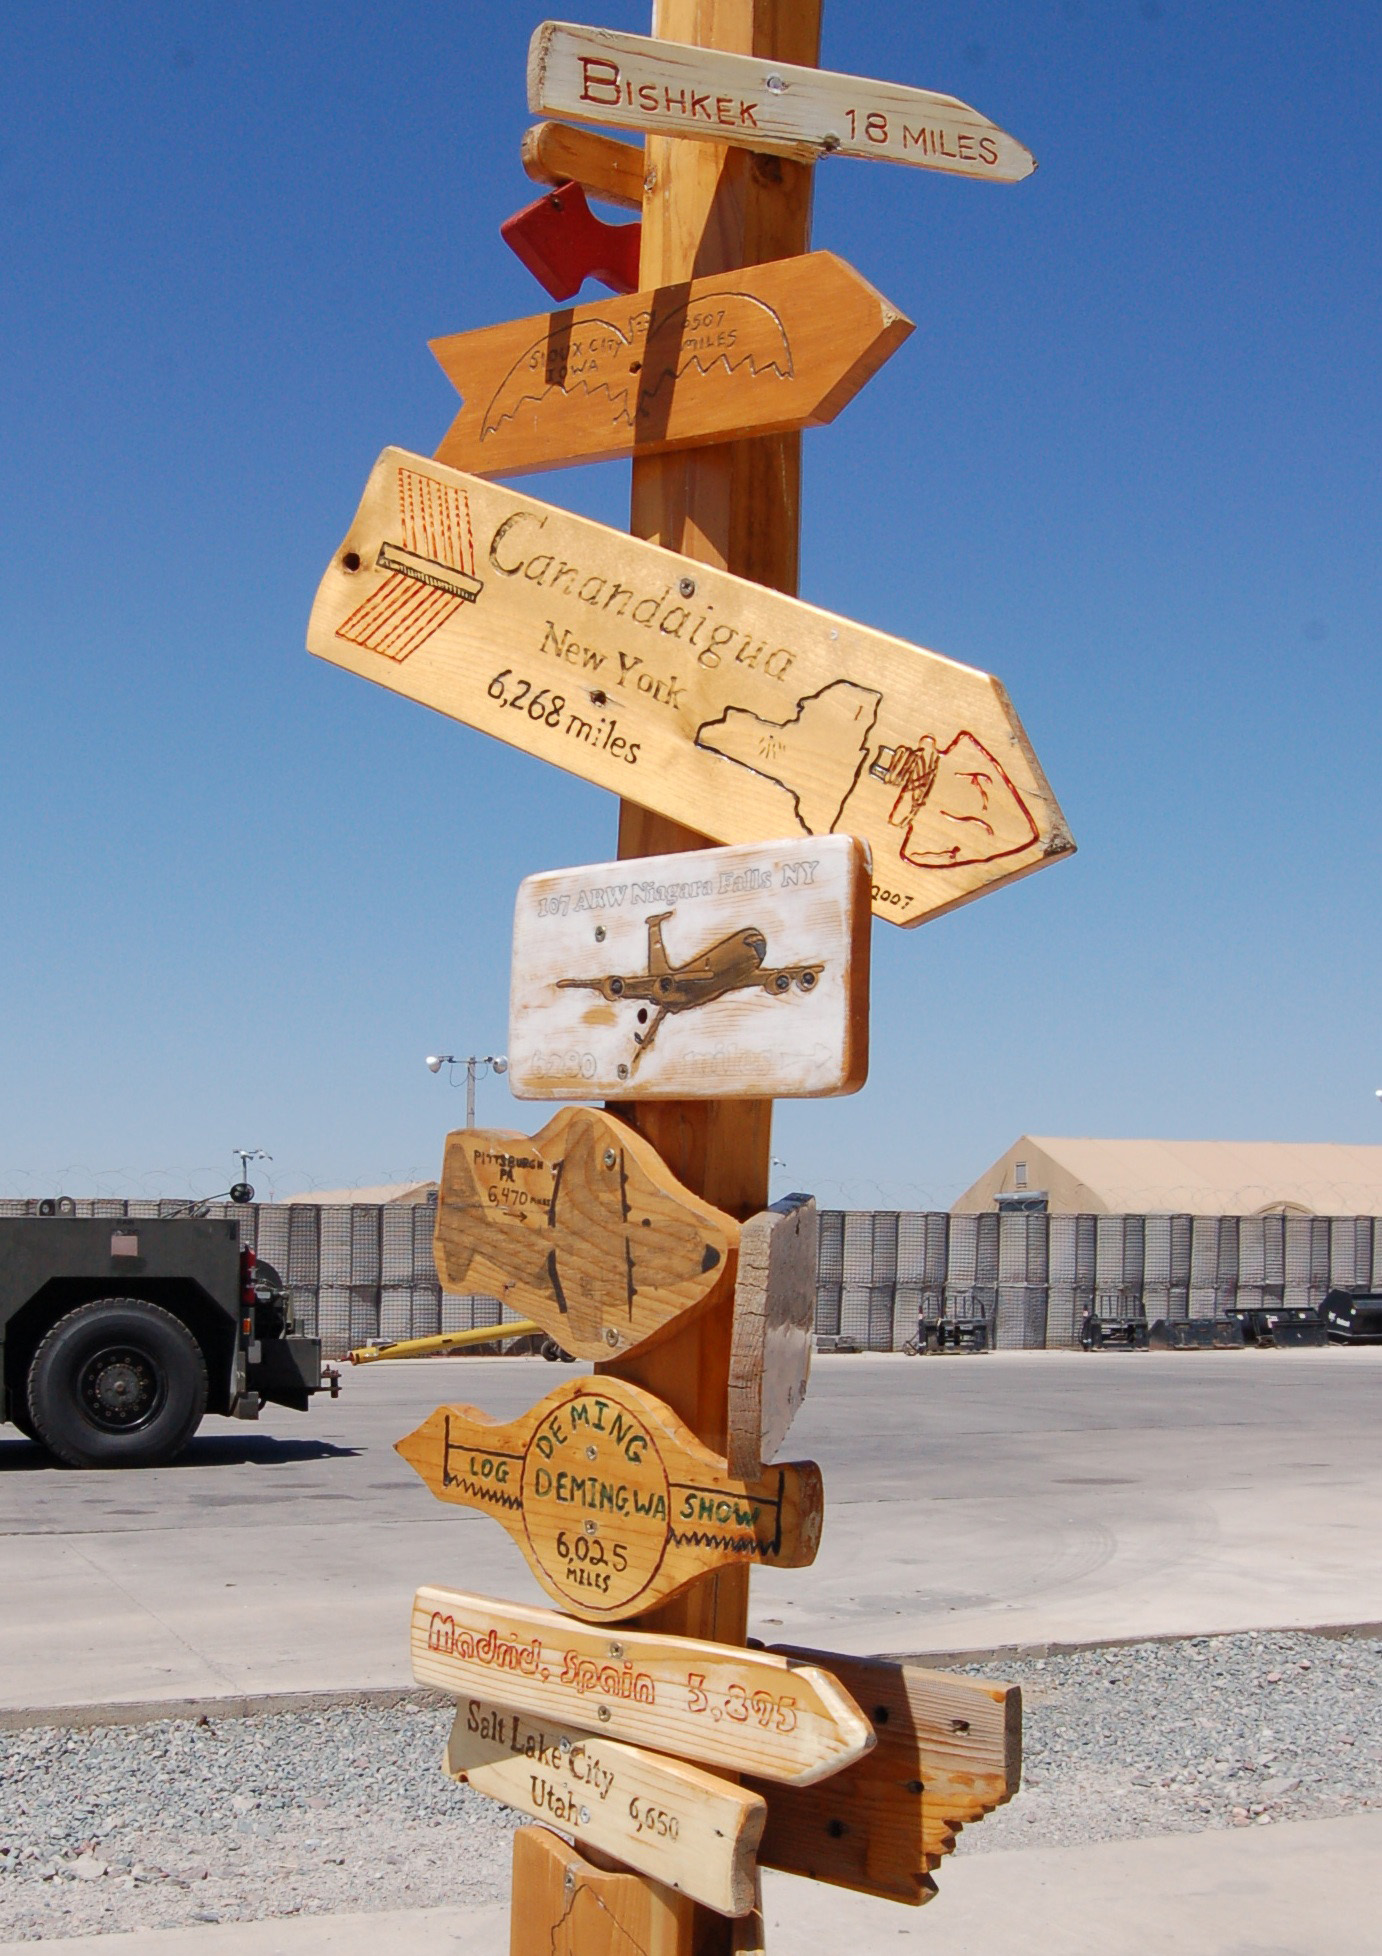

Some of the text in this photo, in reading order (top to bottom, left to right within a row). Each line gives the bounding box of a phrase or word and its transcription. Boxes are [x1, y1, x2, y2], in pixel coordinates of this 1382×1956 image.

[844, 109, 889, 144] 18
[902, 124, 998, 165] MILES
[589, 337, 624, 358] CITY
[489, 511, 797, 683] Canandaigua
[539, 620, 686, 710] New York
[487, 669, 641, 765] 6,268 miles
[537, 860, 820, 917] 107 ARW Niagara Falls NY
[871, 885, 914, 910] 2007
[473, 1149, 544, 1170] PITTSBURGH
[499, 1168, 515, 1183] PA
[488, 1185, 528, 1207] 6,470
[535, 1399, 649, 1466] DEMING
[469, 1456, 511, 1484] LOG
[679, 1493, 761, 1528] SHOW
[555, 1531, 629, 1573] 6,025
[566, 1566, 611, 1593] MILES
[560, 1649, 656, 1706] Spain
[466, 1702, 616, 1799] Salt Lake City
[529, 1775, 579, 1827] Utah
